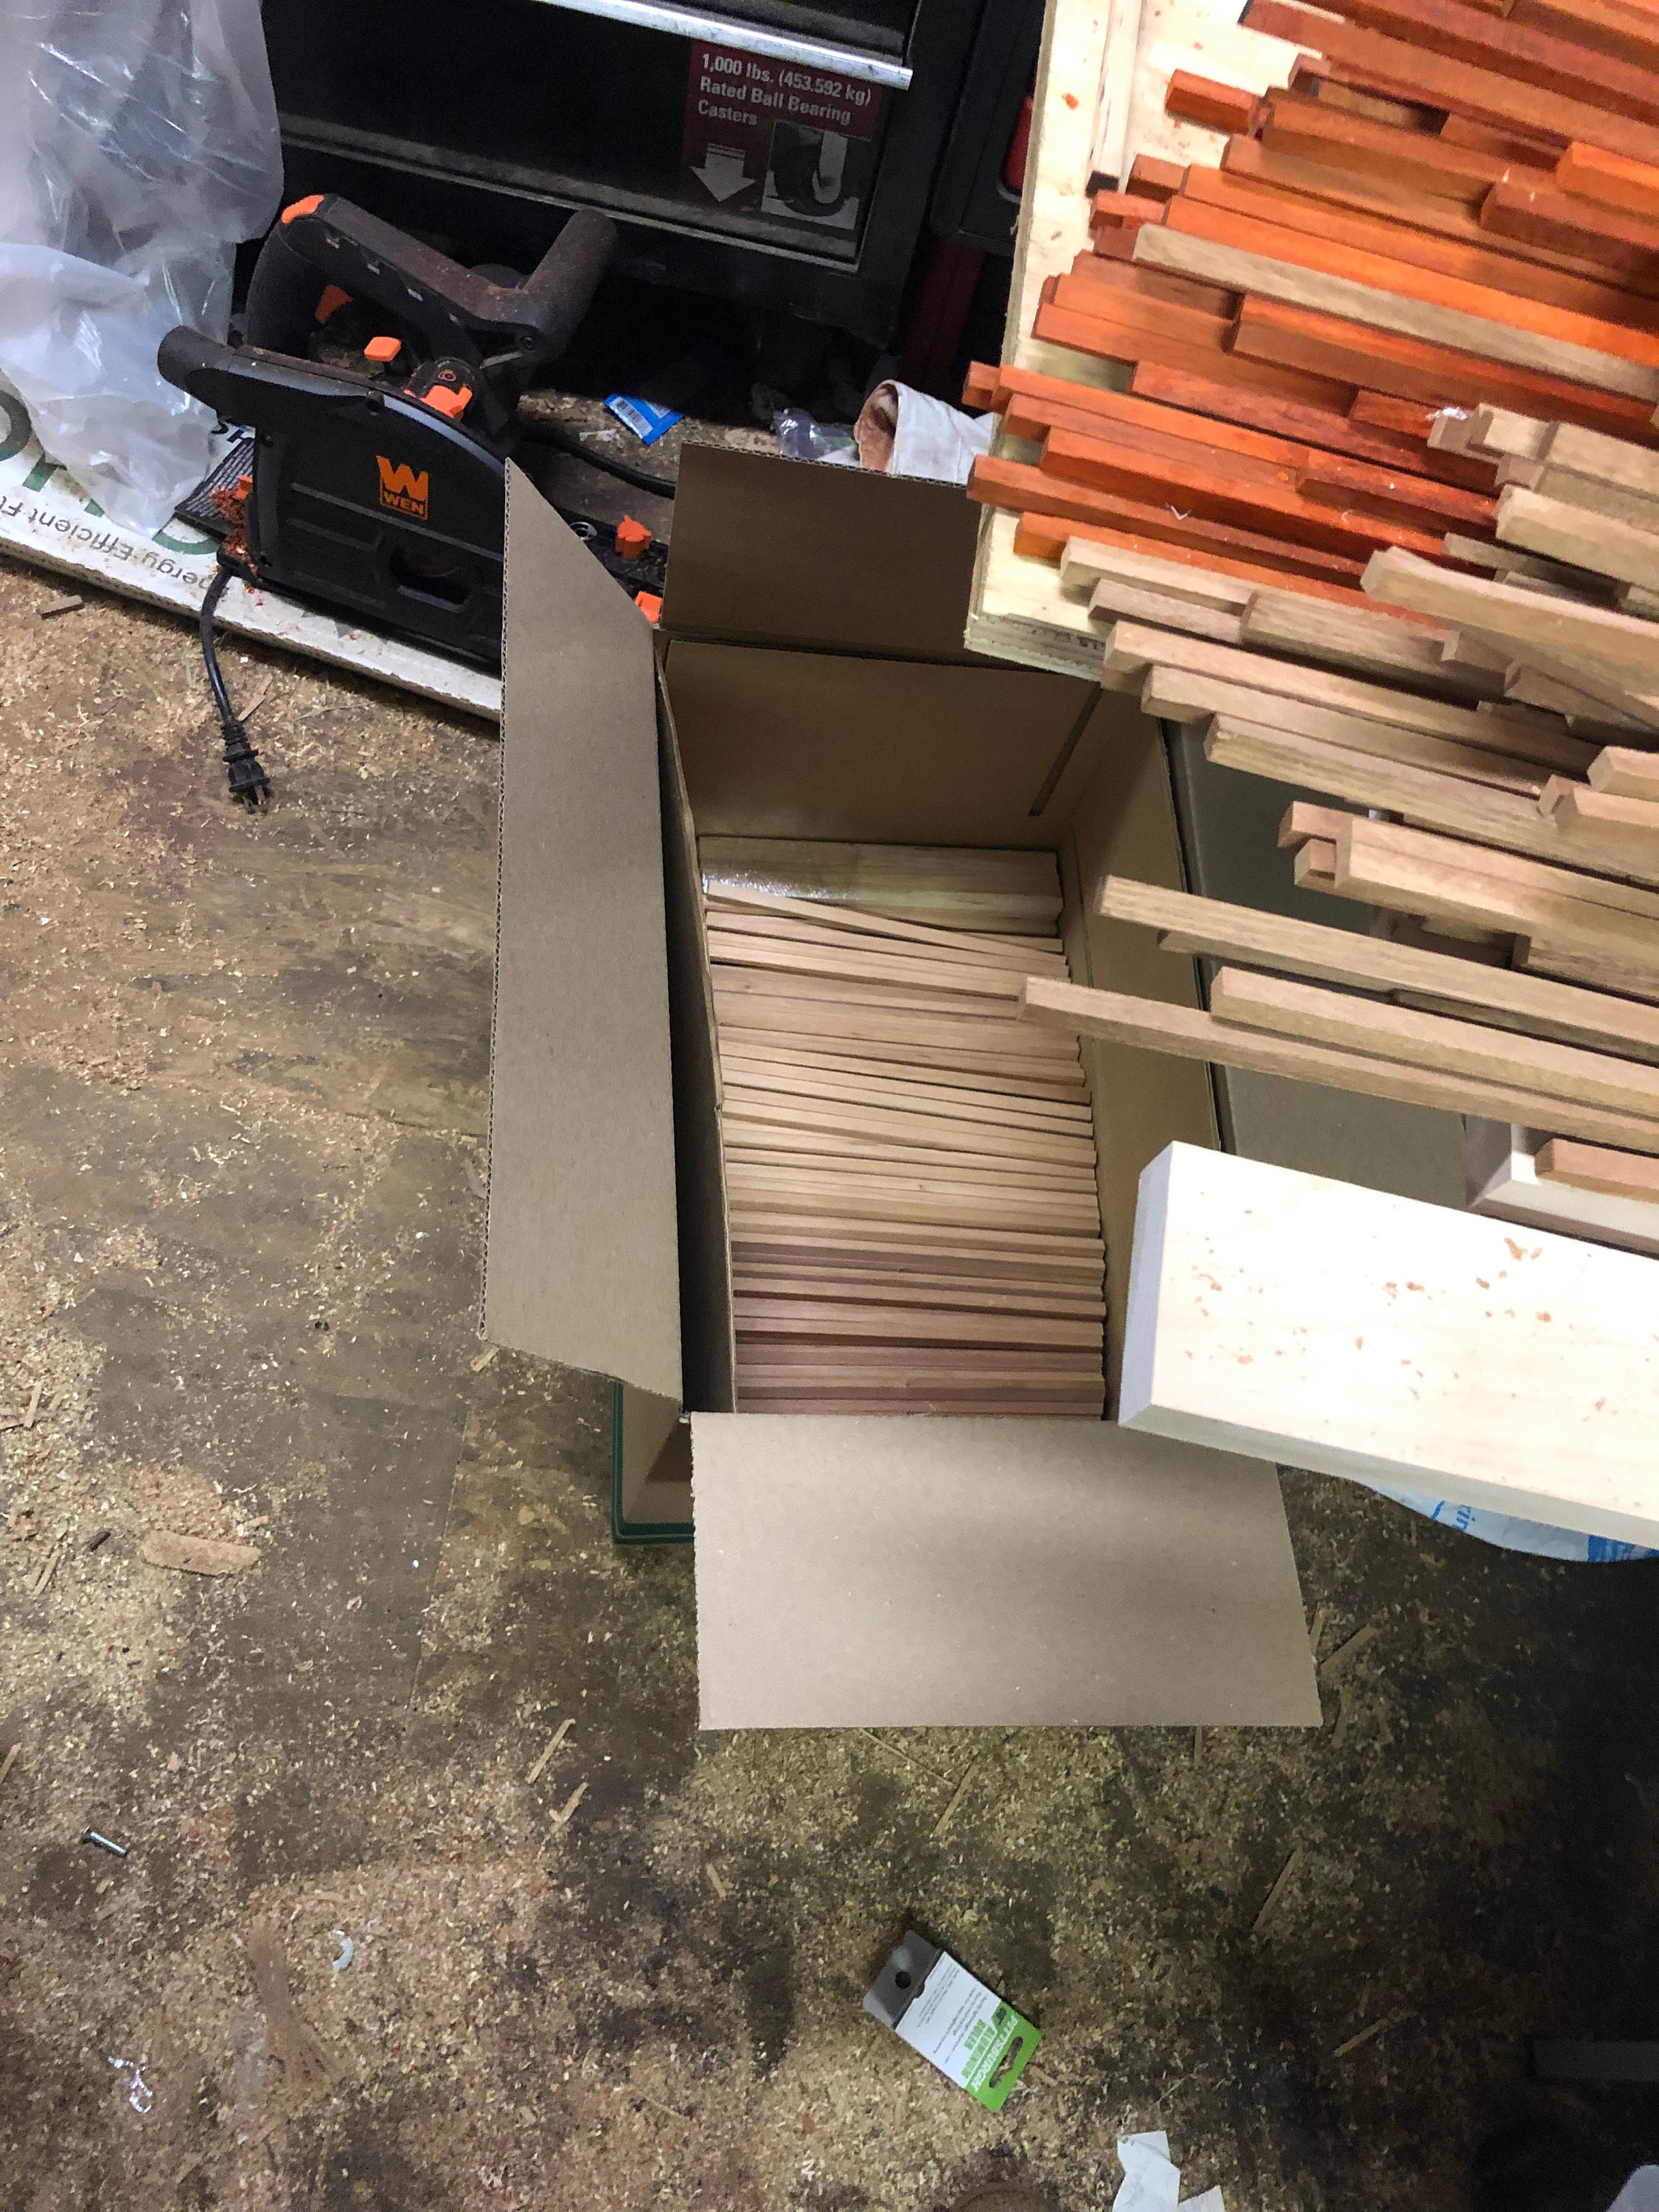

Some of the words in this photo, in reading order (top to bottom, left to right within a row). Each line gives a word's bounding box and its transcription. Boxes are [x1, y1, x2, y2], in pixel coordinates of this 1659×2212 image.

[700, 75, 747, 100] Rated
[751, 87, 785, 108] Ball
[787, 95, 852, 126] Bearing
[702, 53, 742, 76] 1,000
[745, 61, 773, 83] lbs.
[846, 83, 872, 107] kg)
[698, 99, 758, 126] Casters
[383, 490, 425, 515] WEN
[28, 508, 134, 561] Efficient
[970, 2014, 1019, 2092] PITTSBURGH
